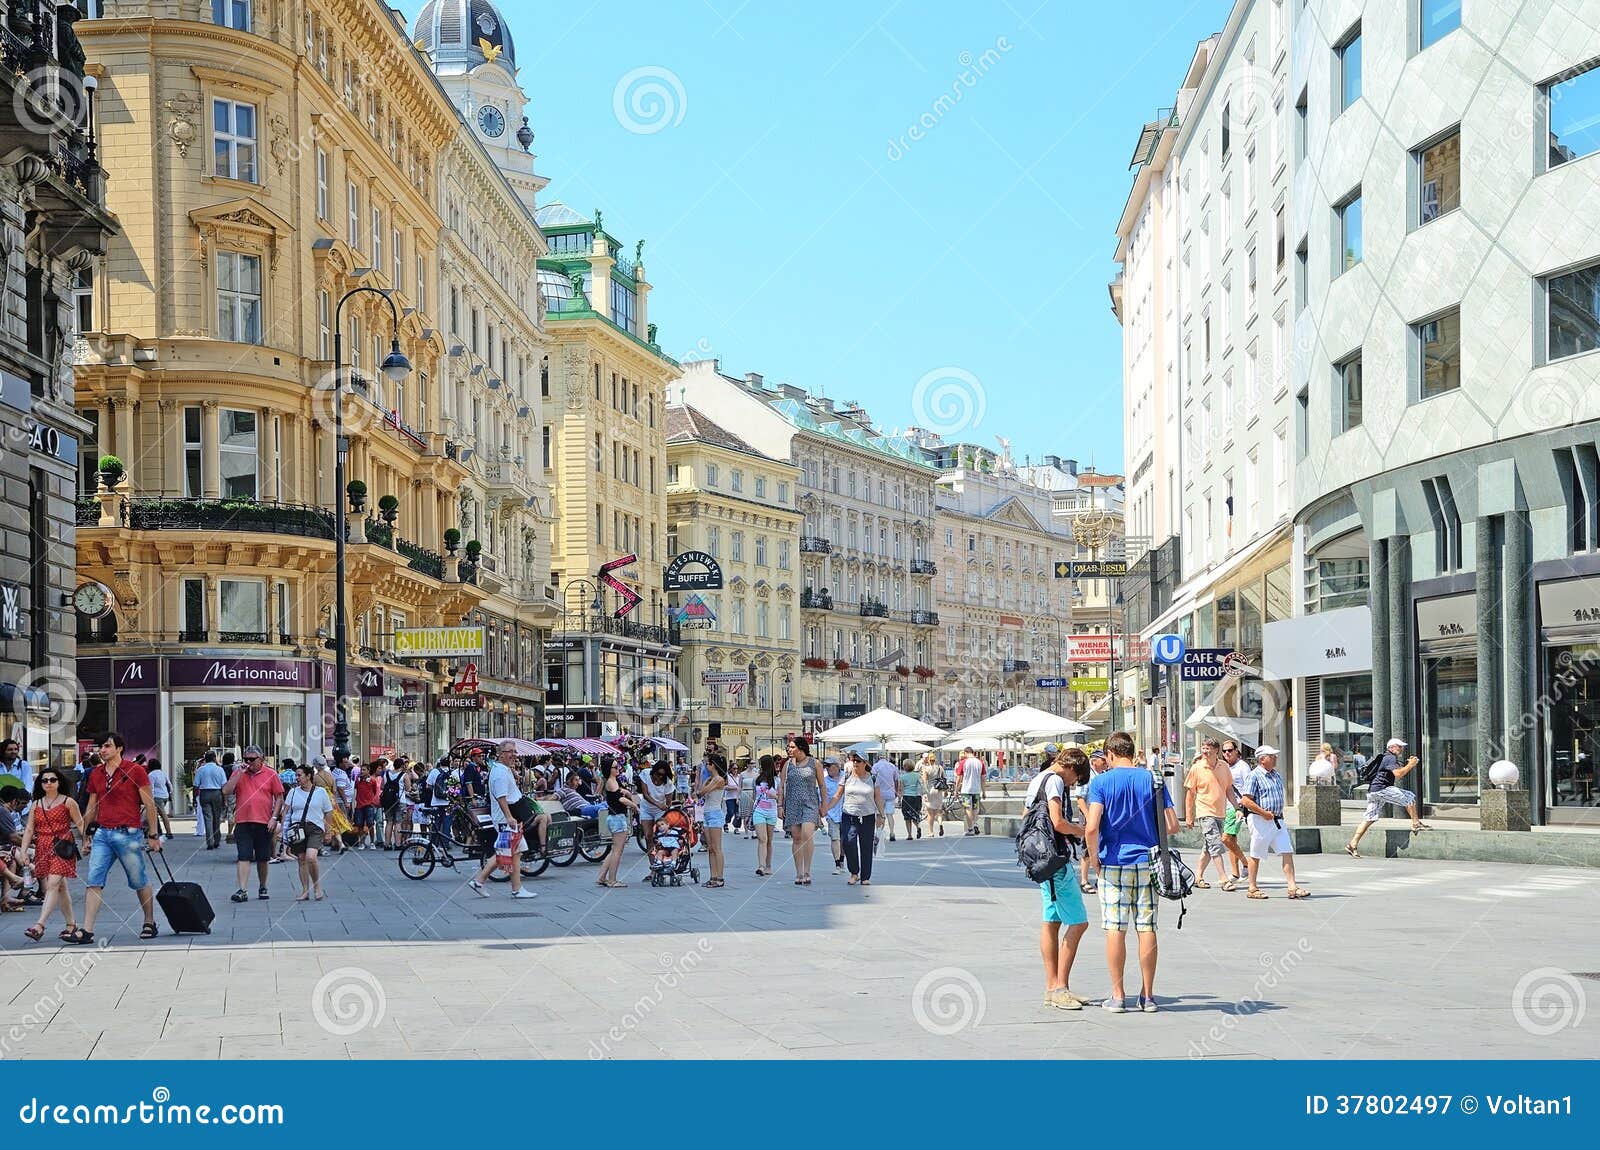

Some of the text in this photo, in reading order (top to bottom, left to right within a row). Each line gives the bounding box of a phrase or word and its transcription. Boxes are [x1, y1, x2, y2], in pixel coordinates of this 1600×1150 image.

[1073, 563, 1126, 573] OMAR BESIM
[678, 574, 710, 582] BUFFET
[1160, 639, 1180, 660] U
[1183, 652, 1214, 664] CAFE
[202, 660, 299, 684] Marionnaud
[1183, 665, 1225, 677] EUROP
[440, 698, 477, 707] APOTHEKE
